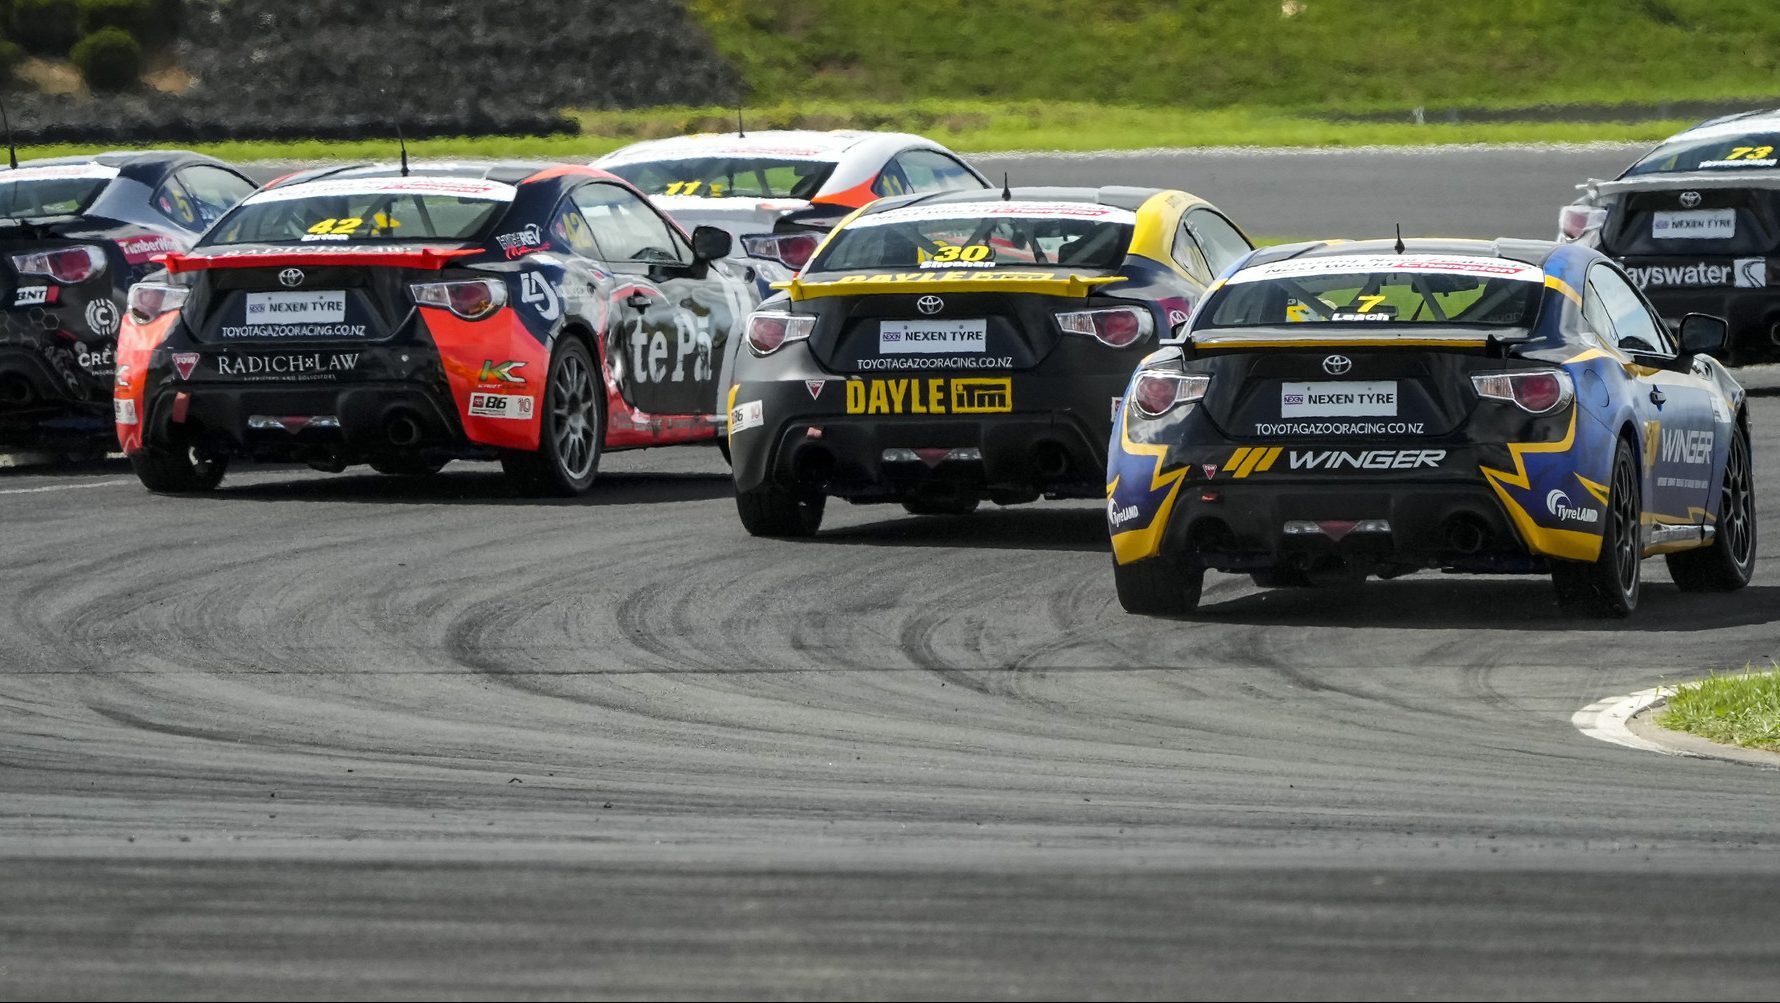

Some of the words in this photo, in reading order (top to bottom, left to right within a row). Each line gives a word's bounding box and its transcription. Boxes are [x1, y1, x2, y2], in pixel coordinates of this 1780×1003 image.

[1724, 145, 1774, 160] 73
[664, 180, 702, 197] 11
[307, 217, 363, 235] 42
[933, 245, 990, 262] 30
[269, 301, 308, 313] NEXEN
[312, 300, 343, 312] TYRE
[1357, 295, 1386, 313] 7
[905, 331, 947, 341] NEXEN
[949, 330, 983, 341] TYRE
[631, 315, 668, 384] te
[217, 355, 305, 375] RADICH
[314, 352, 360, 371] LAW
[857, 357, 1013, 370] TOYOTAGAZOORACING.CO.NZ
[485, 396, 508, 409] 86
[846, 376, 946, 415] DAYLE
[1307, 393, 1355, 405] NEXEN
[1358, 393, 1394, 404] TYRE
[1661, 428, 1715, 465] WINGER
[1289, 449, 1447, 470] WINGER
